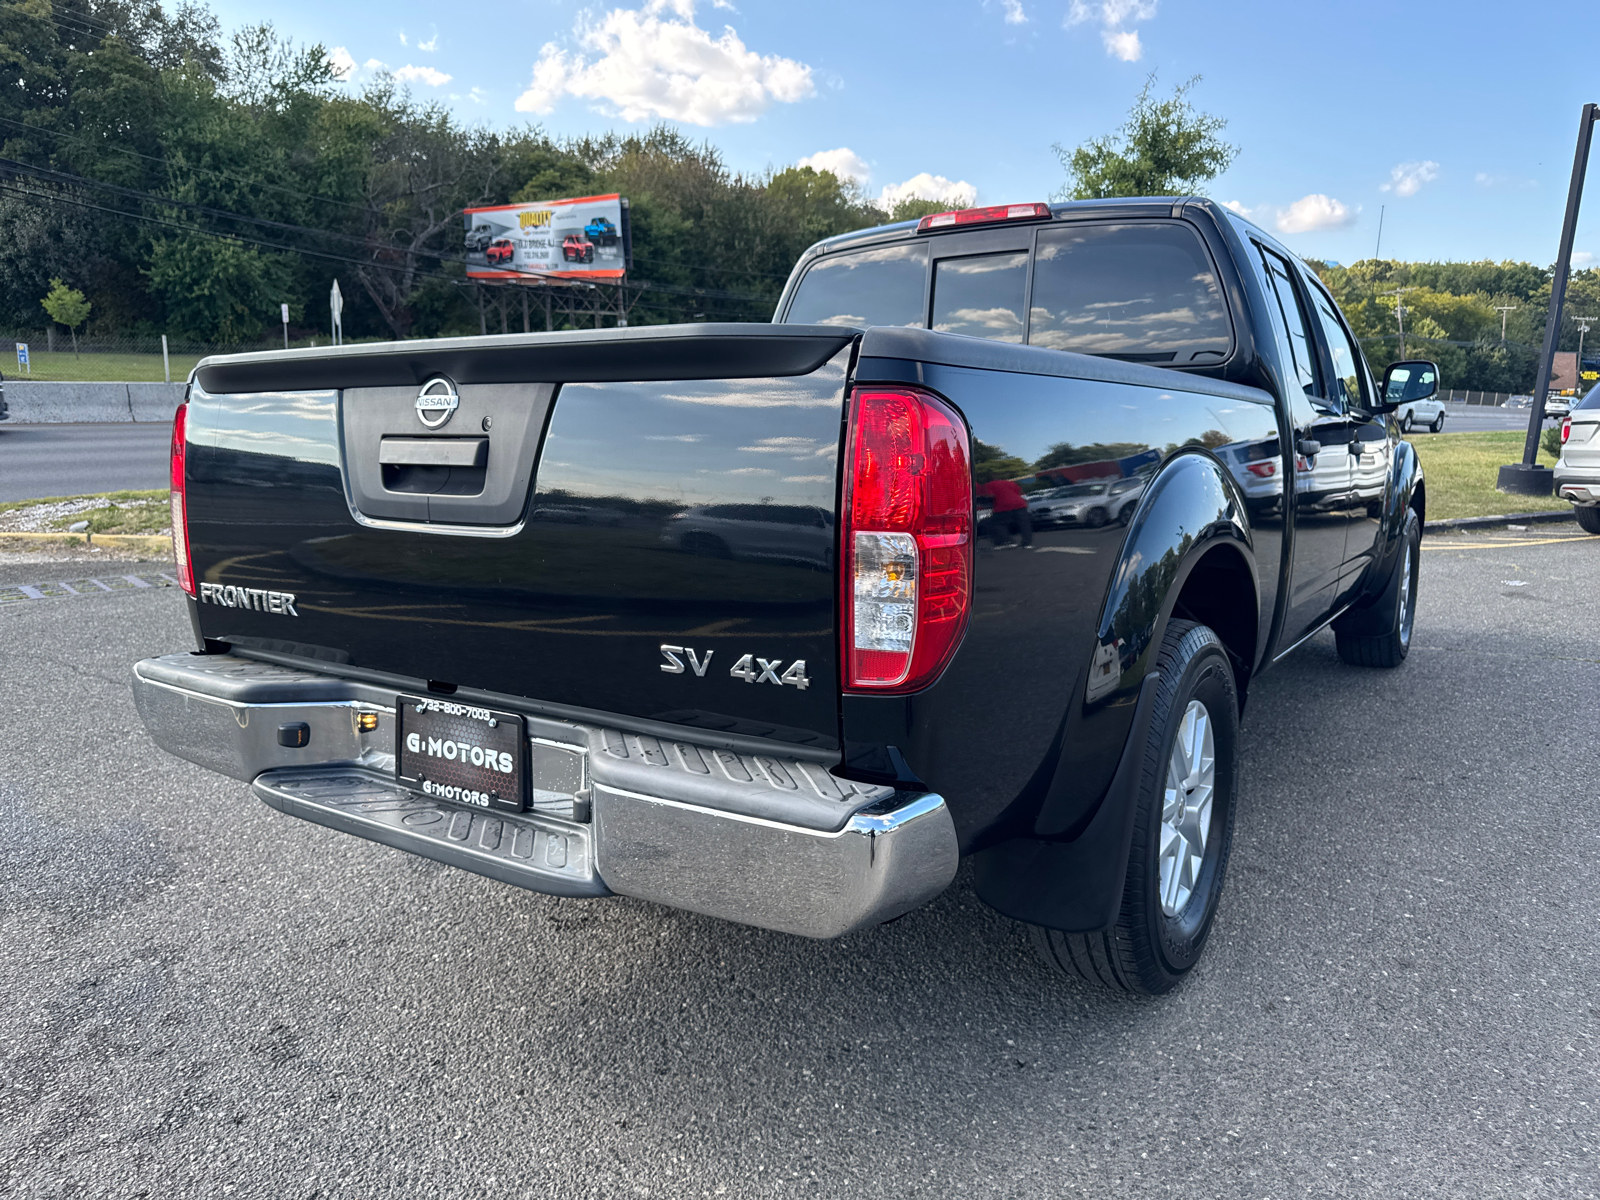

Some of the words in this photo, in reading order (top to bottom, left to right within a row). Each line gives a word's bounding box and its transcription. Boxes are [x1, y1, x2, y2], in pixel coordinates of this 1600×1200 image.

[519, 210, 552, 230] QUALITY
[417, 397, 451, 407] NISSAN
[200, 582, 298, 617] FRONTIER
[660, 644, 714, 677] SV
[421, 700, 490, 720] 732-800-7003
